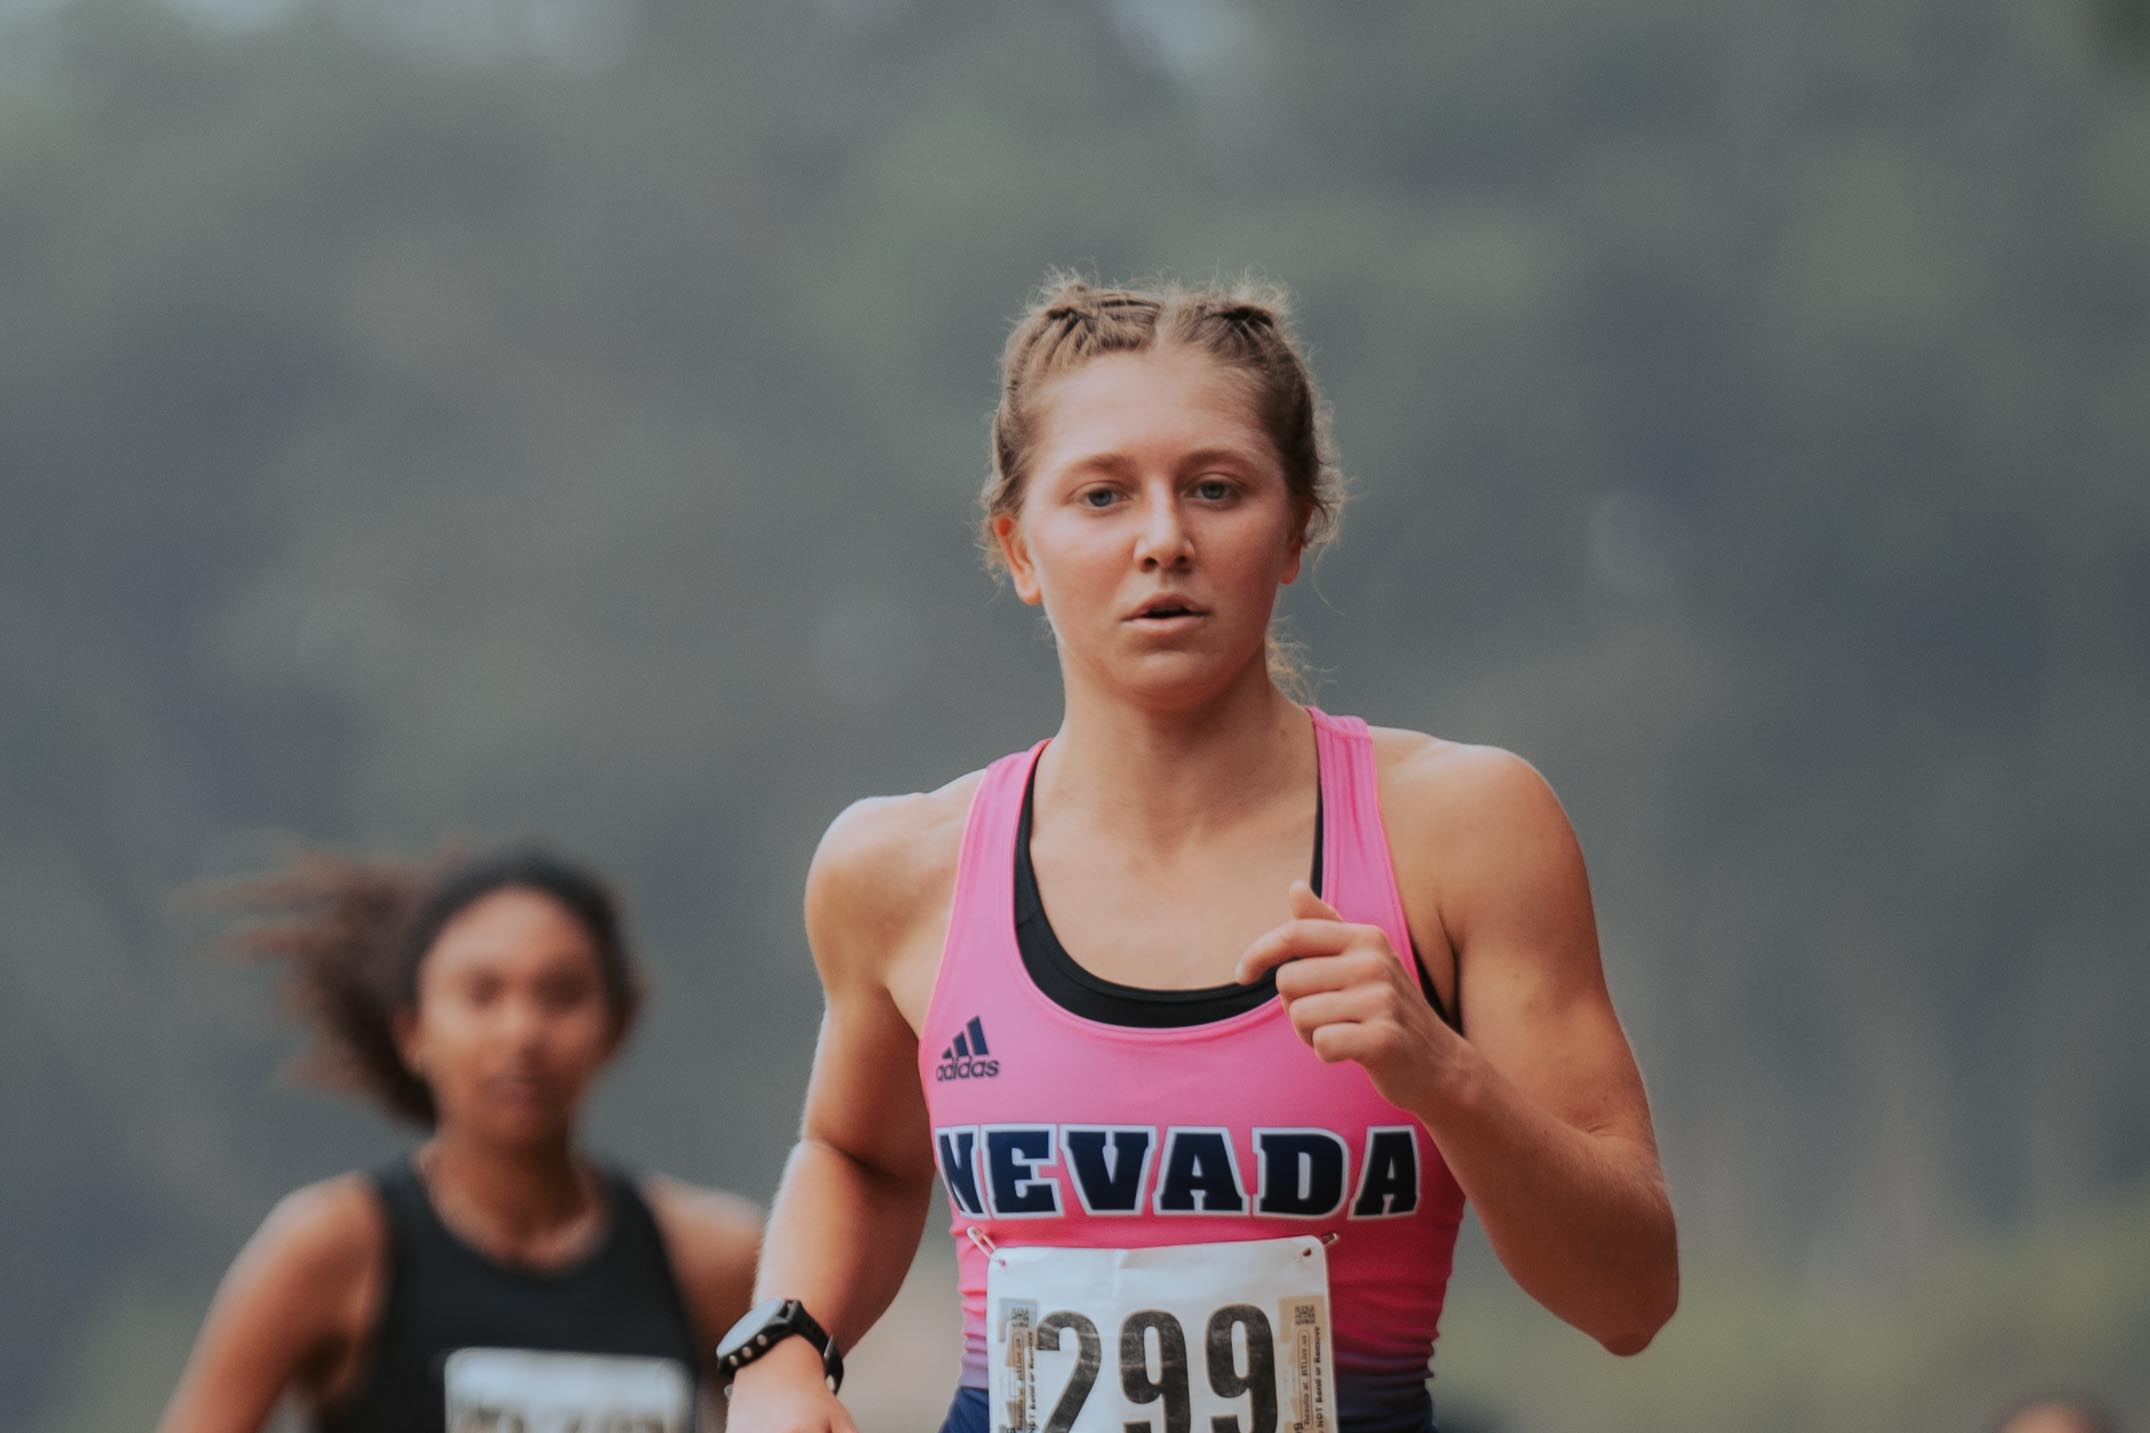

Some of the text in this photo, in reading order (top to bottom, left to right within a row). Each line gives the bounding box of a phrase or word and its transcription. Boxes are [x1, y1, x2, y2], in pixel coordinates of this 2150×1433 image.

[935, 1055, 1000, 1082] adidas
[935, 1123, 1421, 1222] NEVADA
[1036, 1304, 1278, 1433] 299
